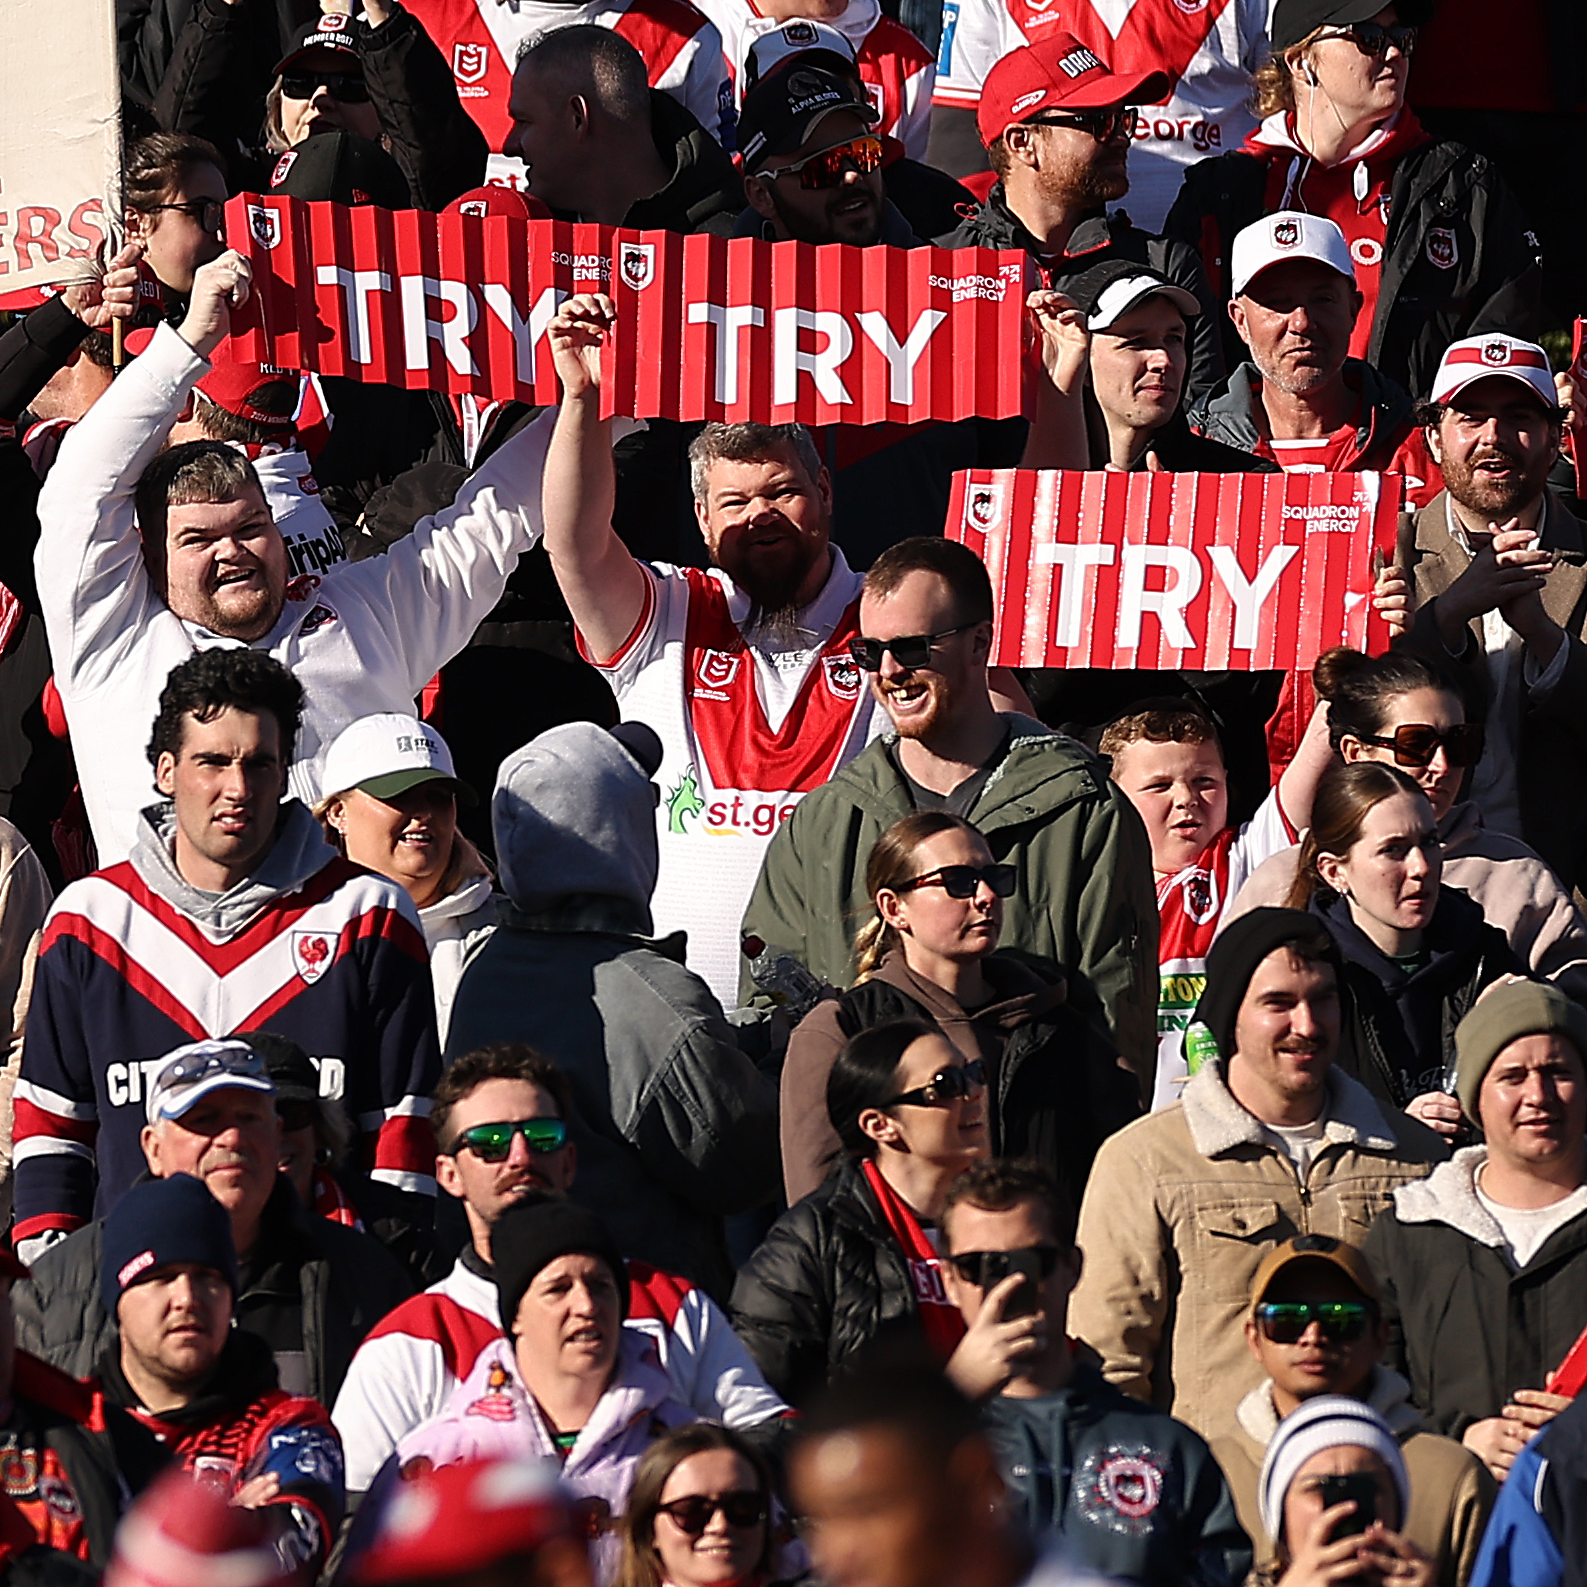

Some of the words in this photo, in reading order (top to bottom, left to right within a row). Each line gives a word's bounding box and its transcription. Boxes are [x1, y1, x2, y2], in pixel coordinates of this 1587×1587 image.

[928, 274, 1006, 299] SQUADRON
[952, 287, 1006, 304] ENERGY
[316, 264, 567, 386] TRY
[688, 300, 947, 408] TRY
[1282, 505, 1360, 520] SQUADRON
[1306, 519, 1359, 534] ENERGY
[1034, 543, 1299, 651] TRY
